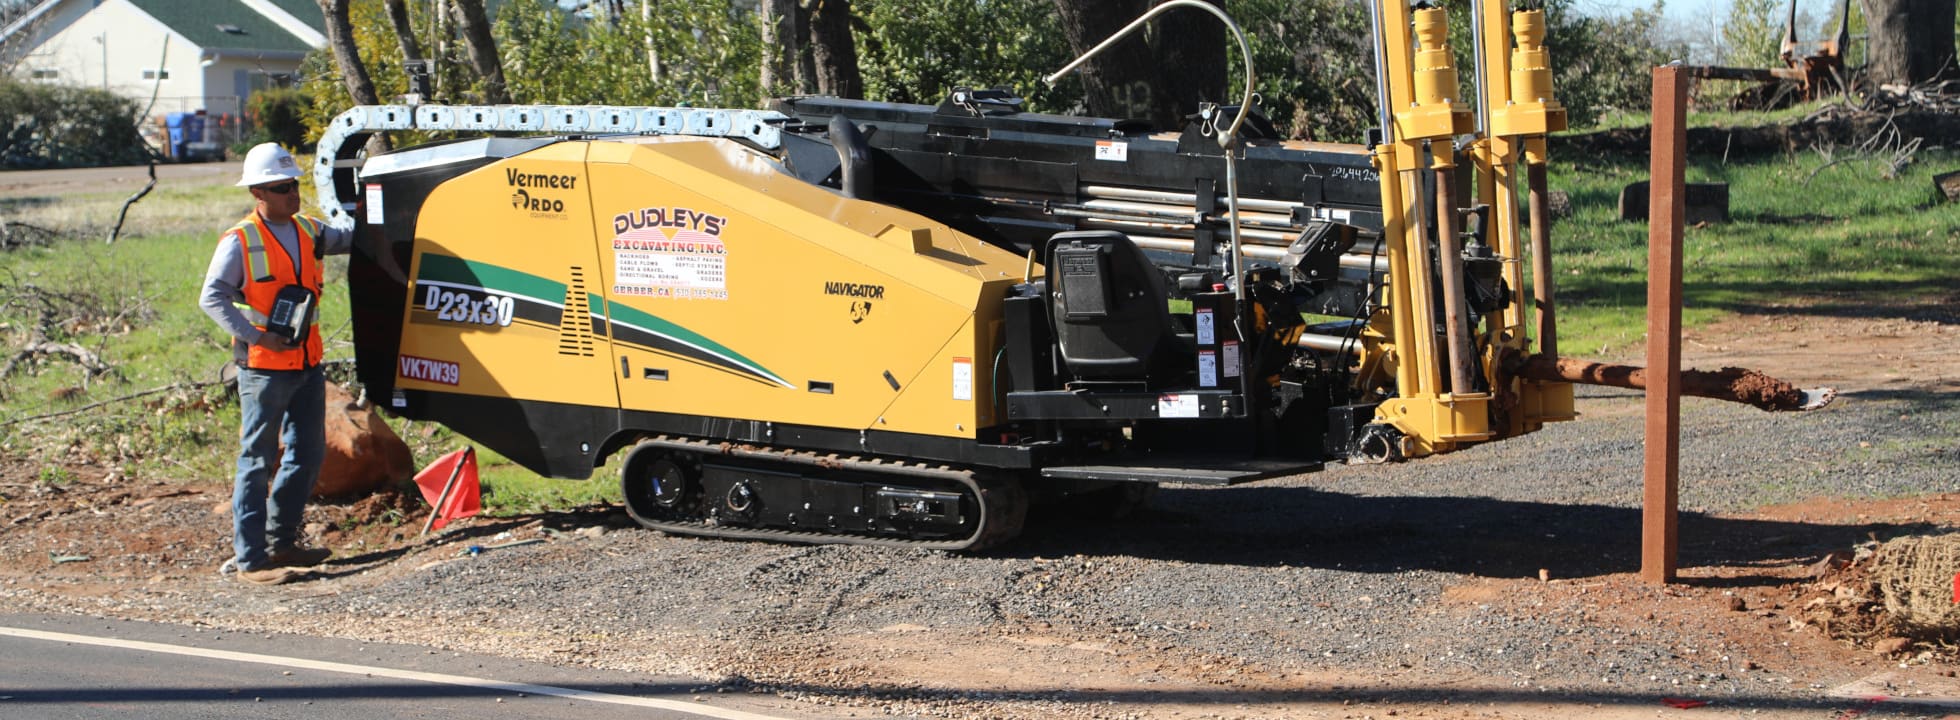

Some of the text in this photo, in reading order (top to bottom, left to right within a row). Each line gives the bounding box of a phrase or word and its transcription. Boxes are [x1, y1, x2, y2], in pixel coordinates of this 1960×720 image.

[506, 167, 577, 189] Vermeer
[531, 197, 564, 213] RDO
[613, 207, 727, 236] DUDLEYS'
[824, 281, 885, 299] NAVIGATOR
[425, 285, 514, 327] D23x30
[400, 356, 459, 384] VK7W39
